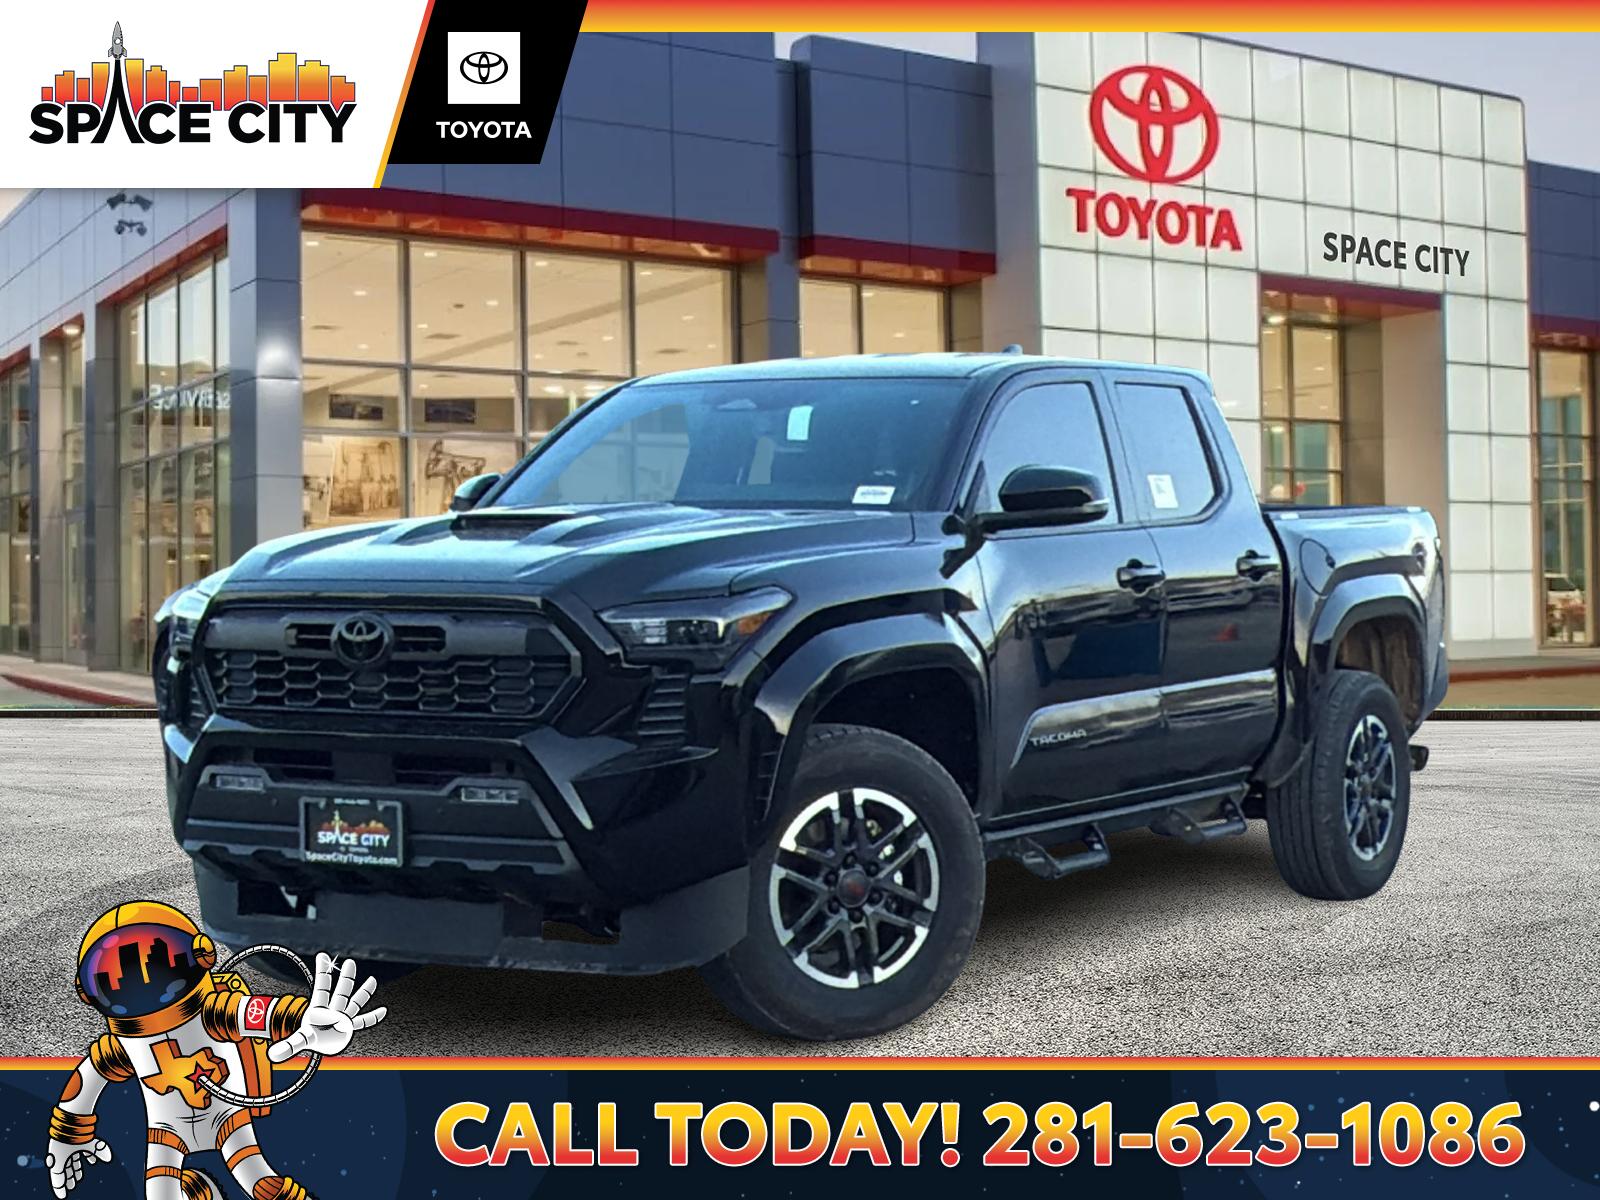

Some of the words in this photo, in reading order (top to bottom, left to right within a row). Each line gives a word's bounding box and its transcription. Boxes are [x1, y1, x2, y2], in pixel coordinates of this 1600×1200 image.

[1066, 188, 1242, 251] TOYOTA
[1323, 232, 1406, 270] SPACE
[1414, 244, 1470, 276] CITY
[1030, 728, 1087, 746] TACOMA
[318, 831, 358, 845] SPACE
[361, 833, 390, 847] CITY
